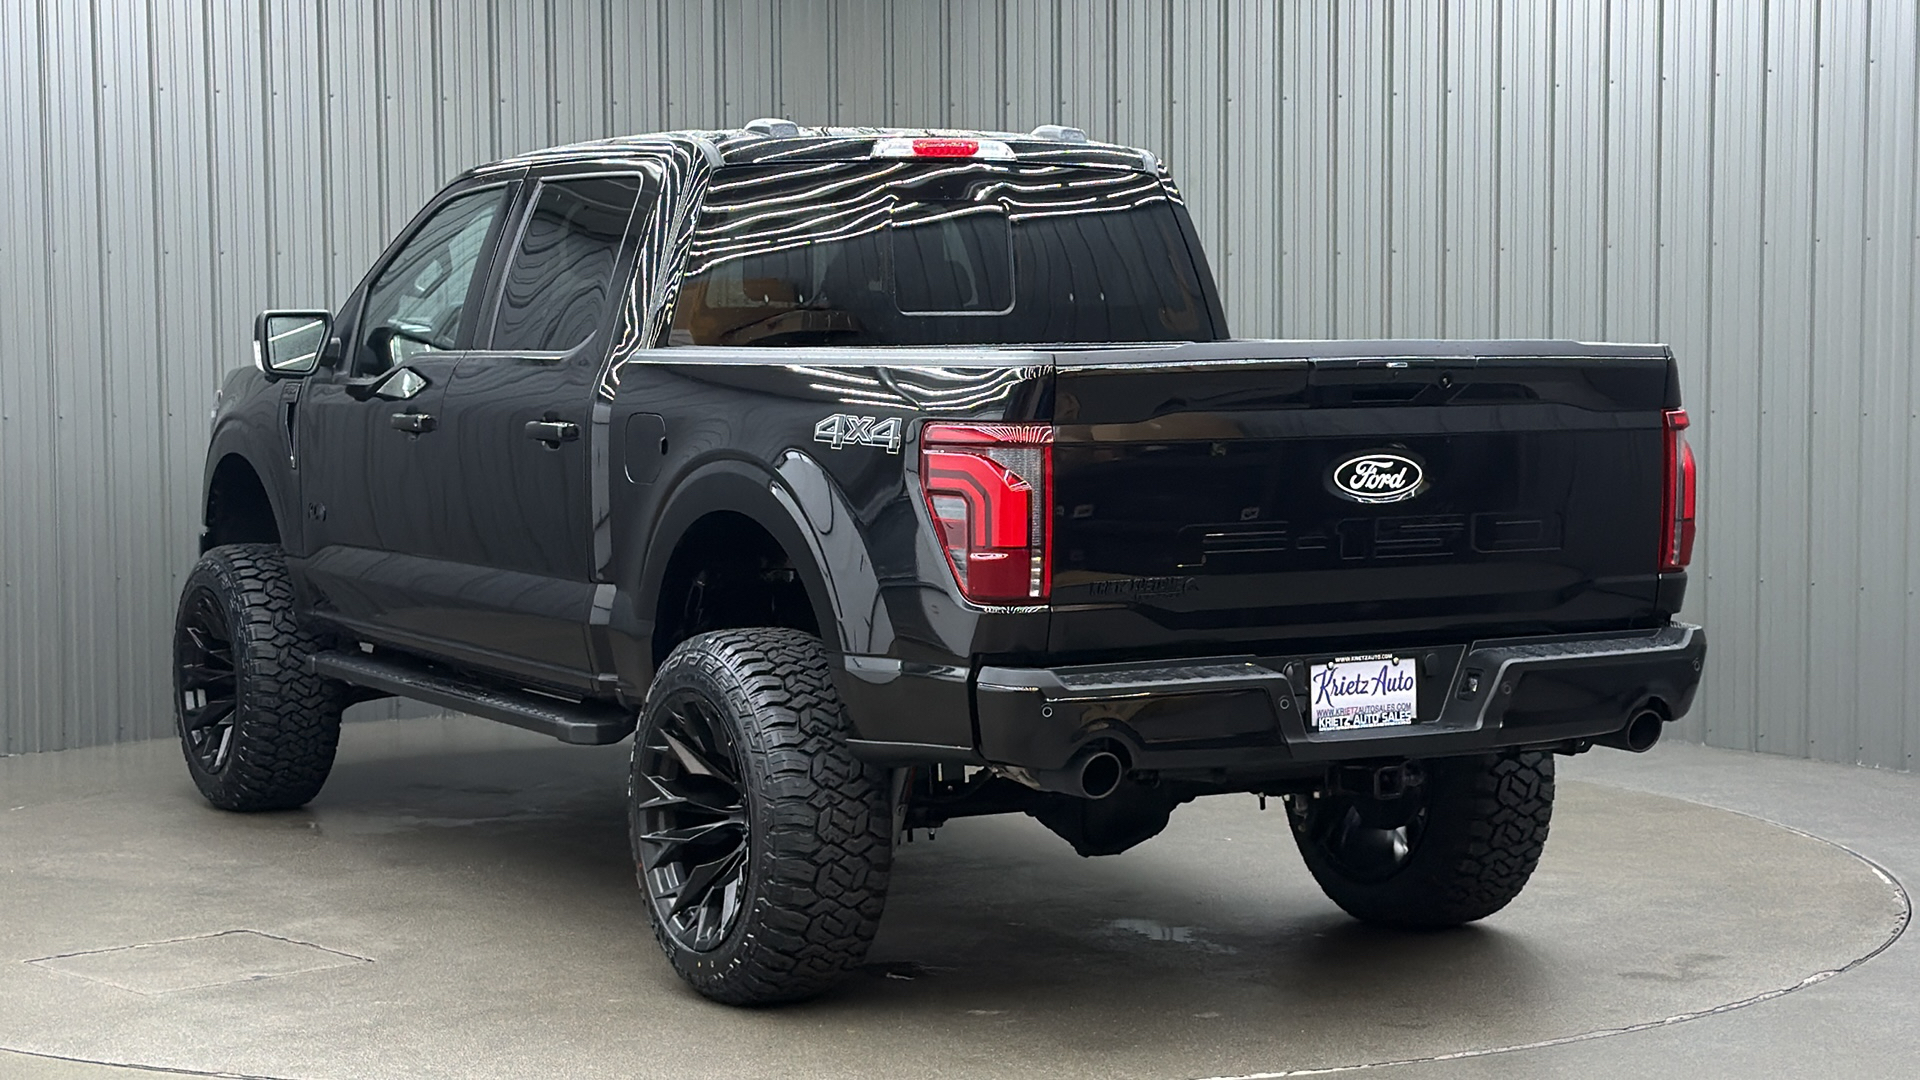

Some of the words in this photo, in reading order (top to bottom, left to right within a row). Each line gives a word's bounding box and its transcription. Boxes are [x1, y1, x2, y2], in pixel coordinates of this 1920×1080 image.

[1349, 461, 1408, 489] Ford
[1177, 511, 1563, 568] F-150
[1334, 653, 1393, 663] WWW.KRIETZAUTO.COM
[1313, 667, 1369, 708] Krietz
[1371, 665, 1414, 696] Auto
[1316, 702, 1412, 718] WWW.KRIETZAUTOSALES.COM
[1318, 715, 1351, 729] KRIETZ
[1353, 713, 1379, 726] AUTO
[1381, 710, 1412, 724] SALES
